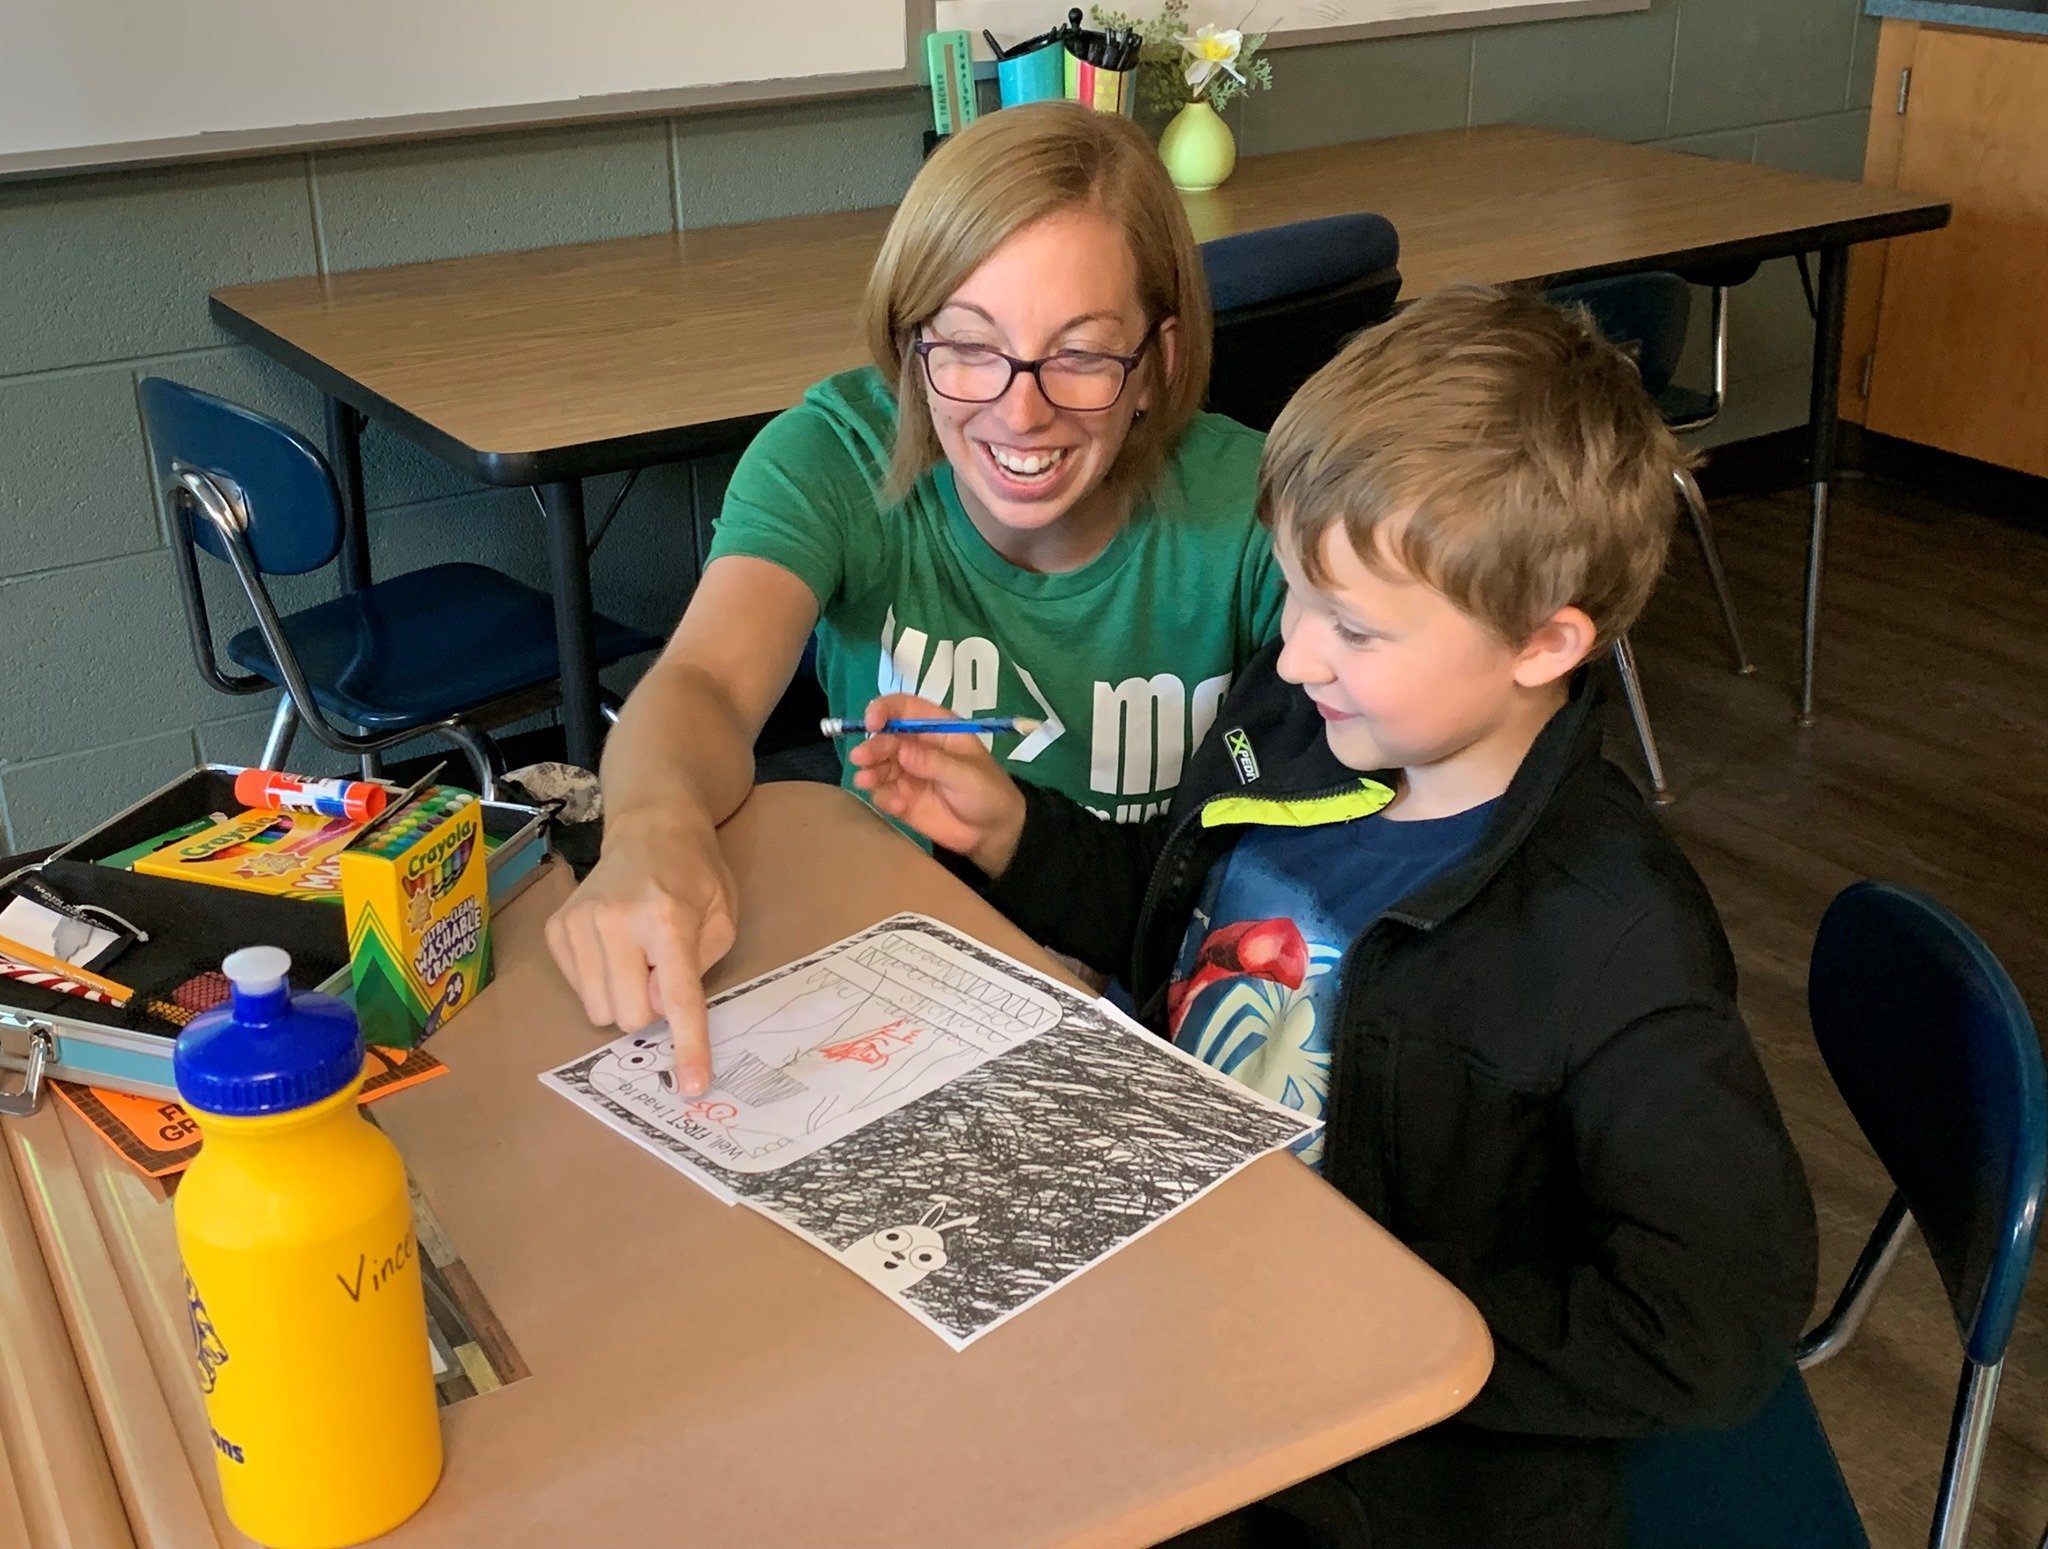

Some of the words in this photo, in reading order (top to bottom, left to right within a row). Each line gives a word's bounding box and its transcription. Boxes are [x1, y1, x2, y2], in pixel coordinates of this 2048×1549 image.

[179, 816, 280, 857] Crayola
[408, 820, 472, 877] Crayola
[413, 908, 481, 975] WASHABLE
[421, 897, 475, 948] ULTRA-CLEAN
[426, 932, 477, 986] CRAYONS
[447, 975, 463, 1003] 24
[631, 1093, 666, 1114] had
[666, 1115, 712, 1141] FIRST
